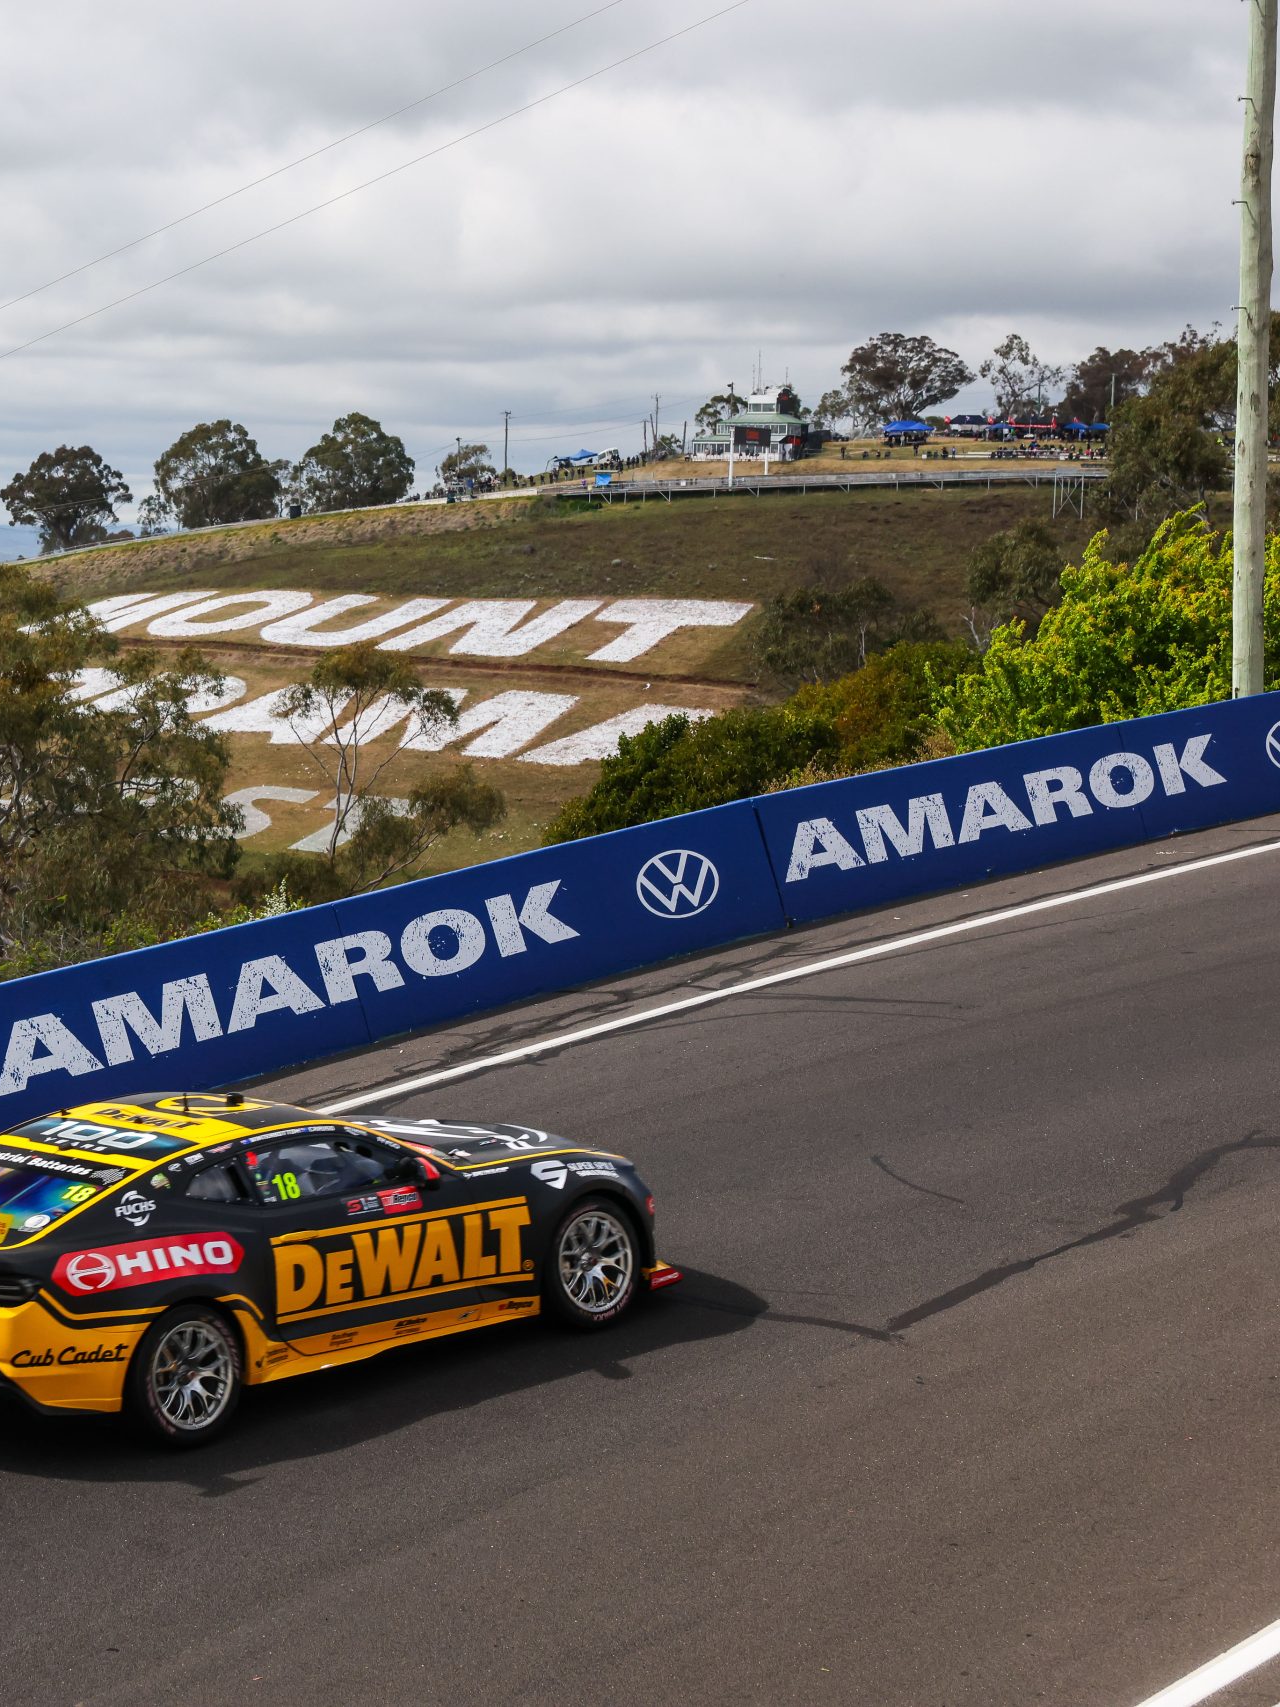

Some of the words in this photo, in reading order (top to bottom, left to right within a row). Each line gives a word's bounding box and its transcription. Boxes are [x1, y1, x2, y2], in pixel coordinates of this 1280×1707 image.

[786, 734, 1227, 883] AMAROK
[40, 1121, 158, 1150] 100
[44, 1137, 108, 1151] YEARS
[27, 1157, 93, 1176] Batteries
[61, 1184, 97, 1203] 18
[271, 1171, 301, 1200] 18
[115, 1200, 157, 1217] FUCHS
[117, 1239, 235, 1278] HINO
[11, 1350, 54, 1367] Cub
[58, 1343, 129, 1366] Cadet
